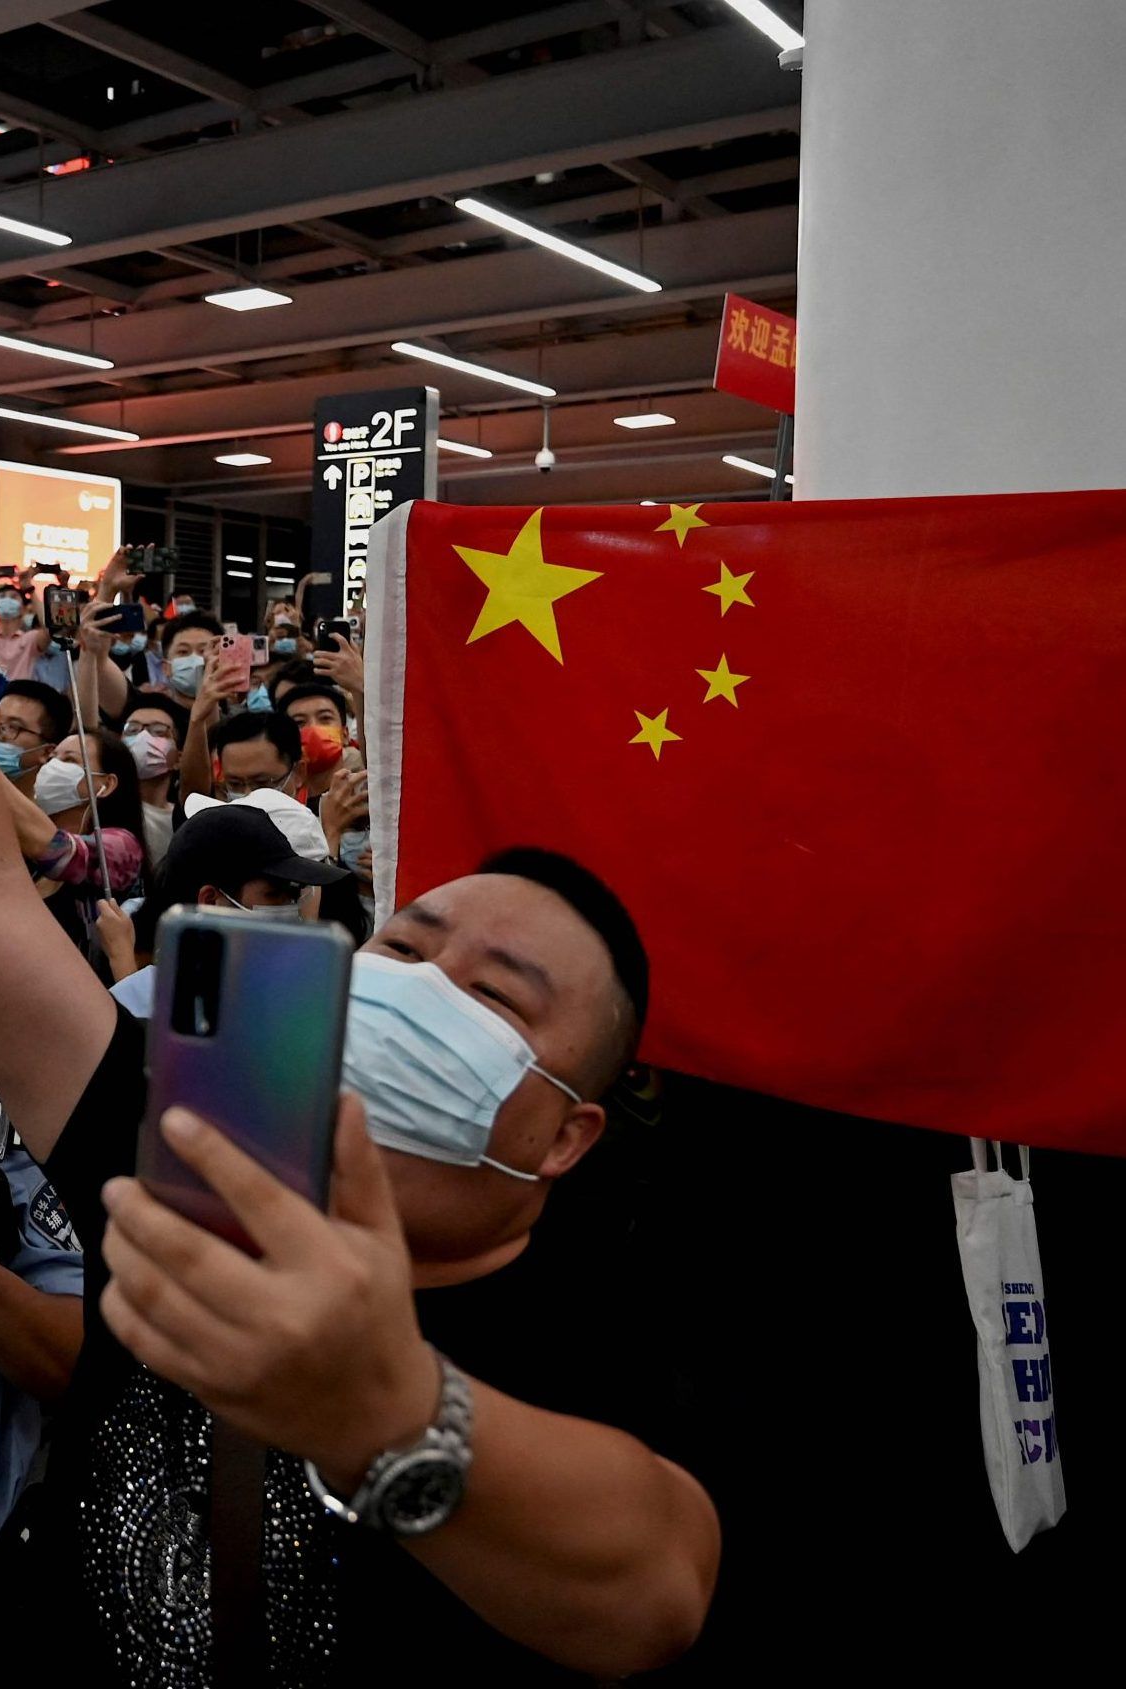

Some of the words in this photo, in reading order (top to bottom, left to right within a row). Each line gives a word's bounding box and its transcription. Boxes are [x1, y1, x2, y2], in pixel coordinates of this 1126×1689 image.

[727, 308, 796, 368] 欢迎孟
[370, 408, 418, 448] 2F
